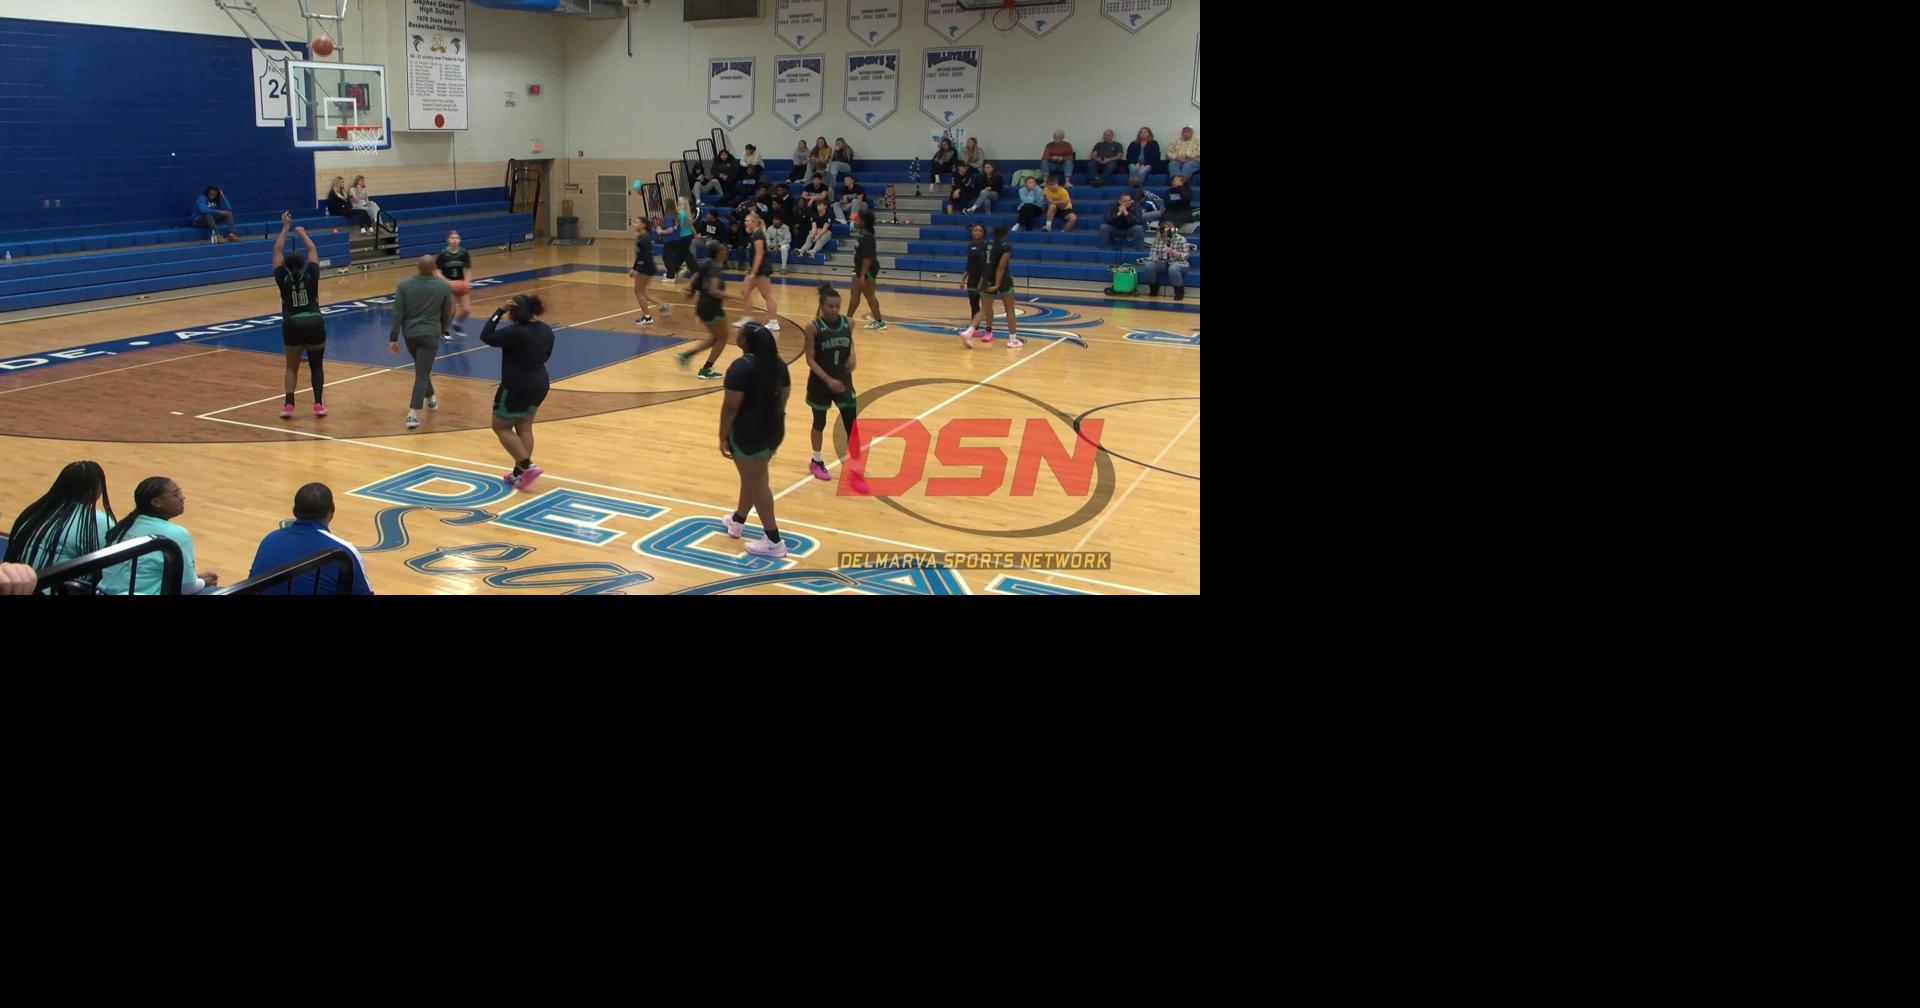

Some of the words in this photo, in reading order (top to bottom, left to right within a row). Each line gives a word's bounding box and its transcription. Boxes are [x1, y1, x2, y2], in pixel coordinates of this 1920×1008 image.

[419, 6, 433, 14] High
[435, 8, 455, 16] School
[408, 21, 436, 30] Basketball
[436, 25, 464, 33] Champions
